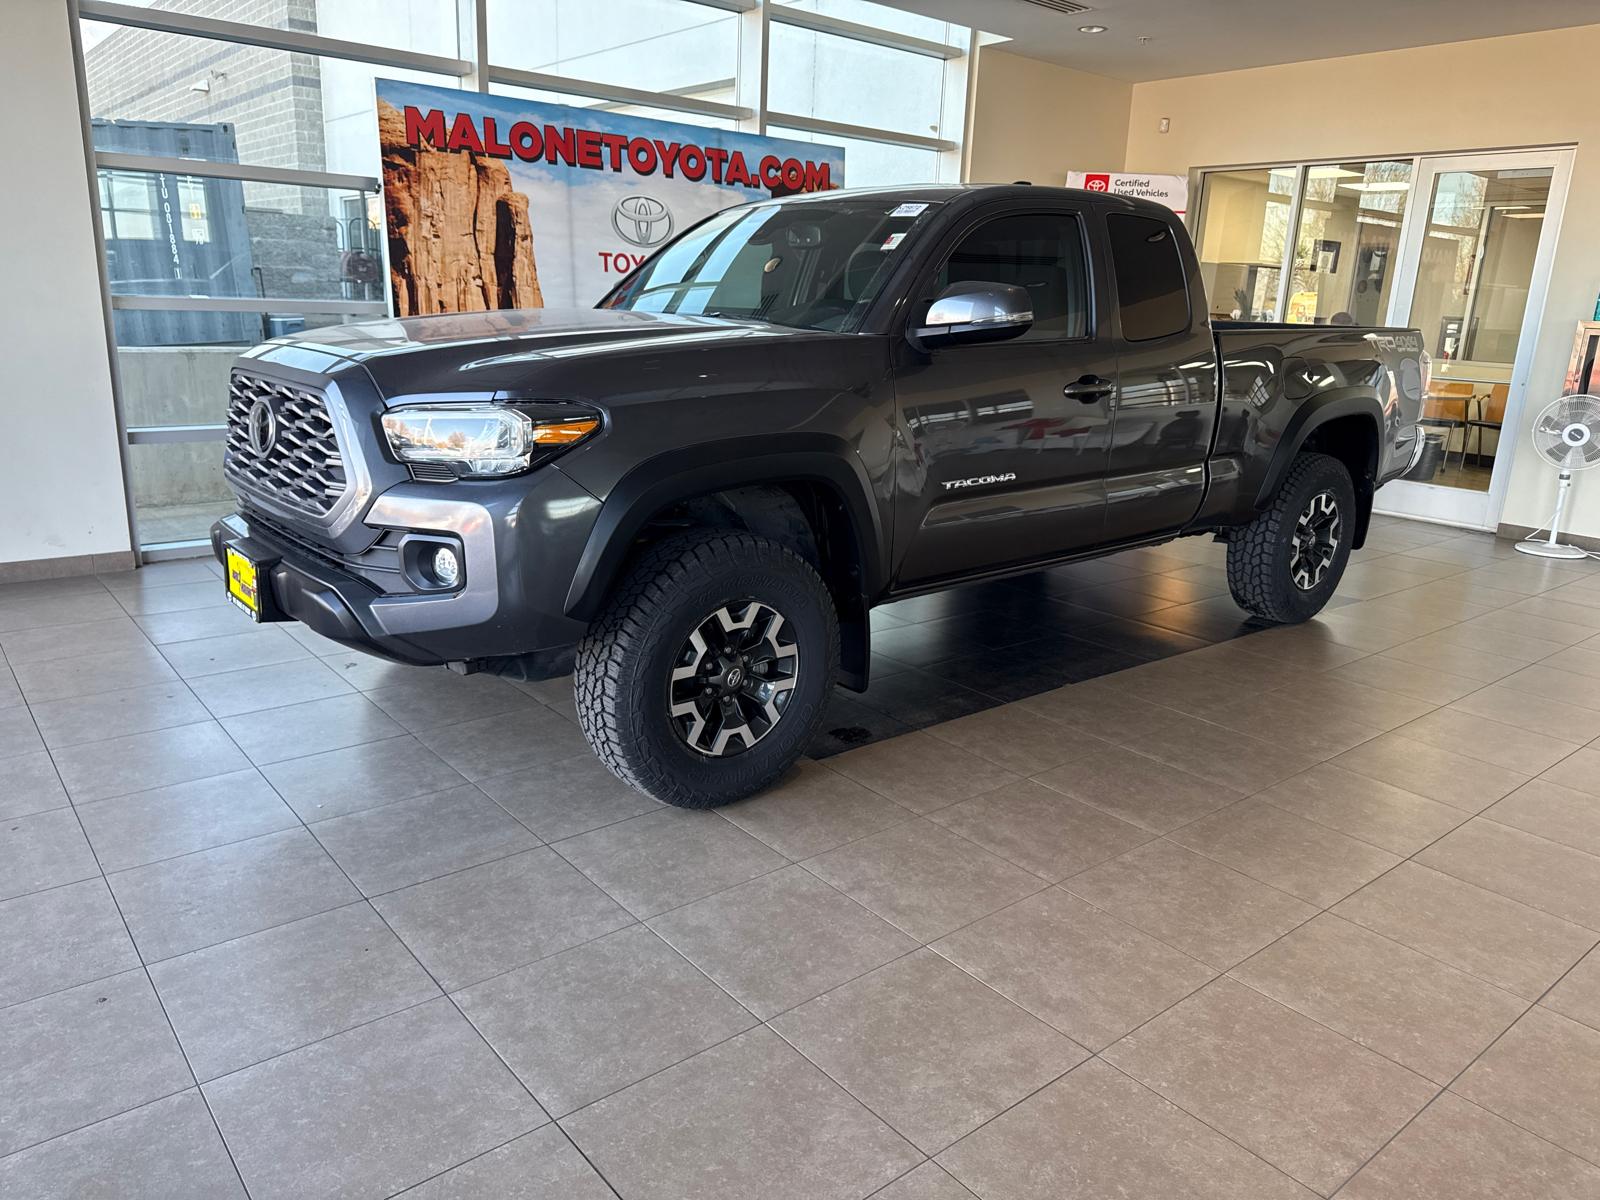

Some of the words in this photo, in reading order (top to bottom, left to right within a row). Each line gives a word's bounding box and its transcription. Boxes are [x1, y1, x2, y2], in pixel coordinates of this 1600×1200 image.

[403, 105, 831, 192] MALONETOYOTA.COM
[1114, 179, 1150, 187] Certified
[1114, 188, 1134, 196] Used
[1136, 189, 1169, 198] Vehicles
[1365, 336, 1396, 352] TRD
[940, 472, 1017, 490] TACOMA
